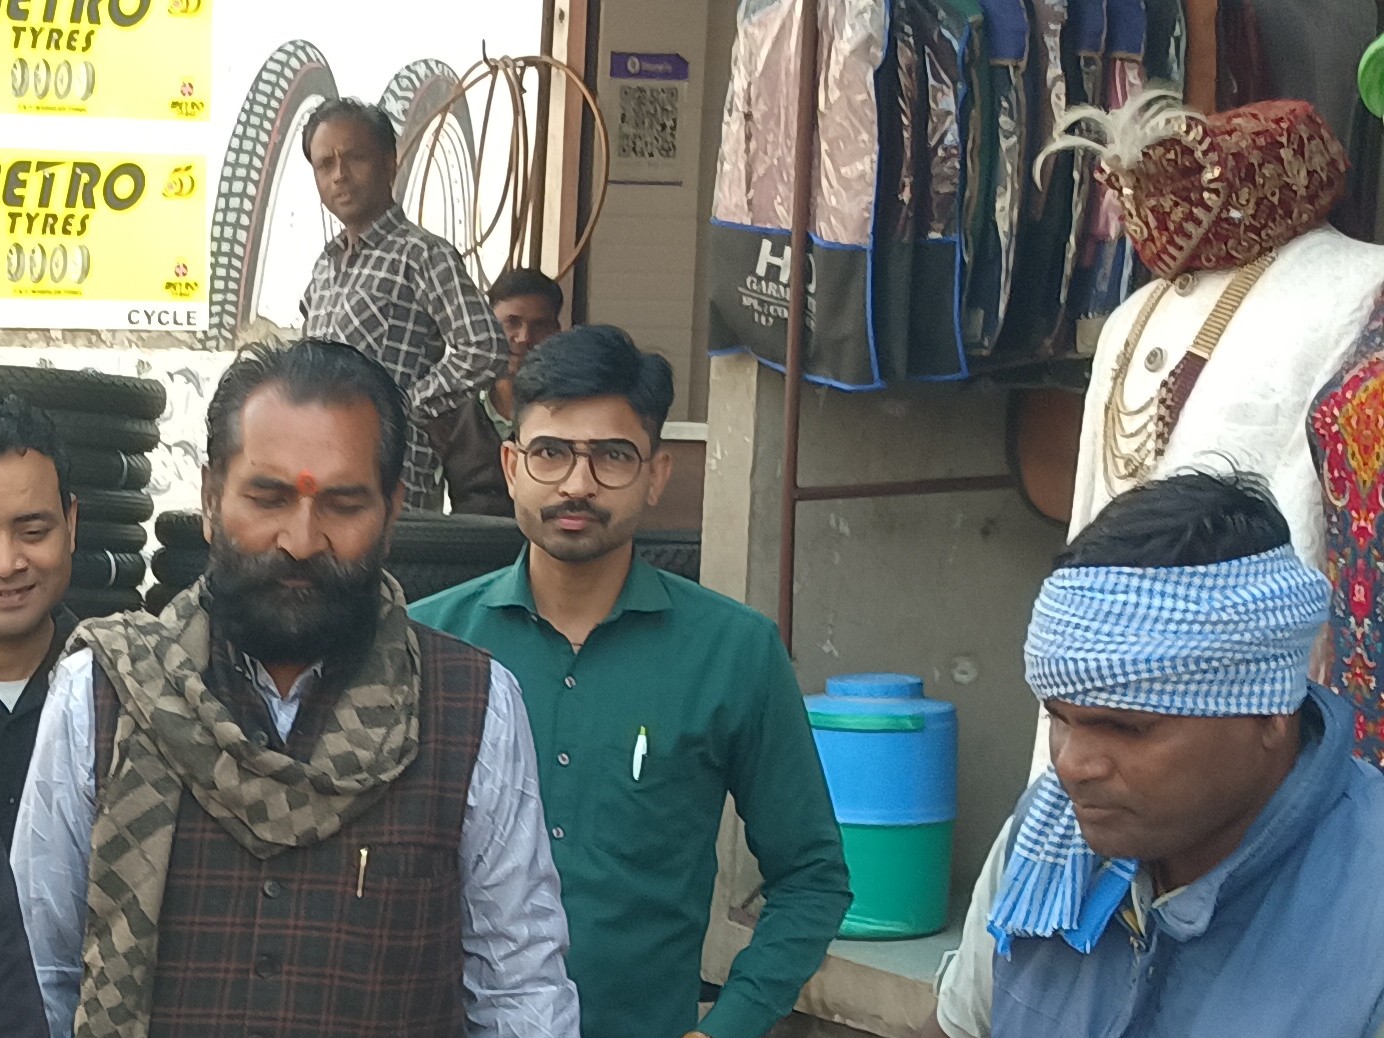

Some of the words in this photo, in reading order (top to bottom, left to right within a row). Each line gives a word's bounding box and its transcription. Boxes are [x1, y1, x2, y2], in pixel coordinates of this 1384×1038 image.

[12, 26, 96, 52] TYRES
[7, 212, 90, 236] TYRES
[127, 309, 198, 327] CYCLE
